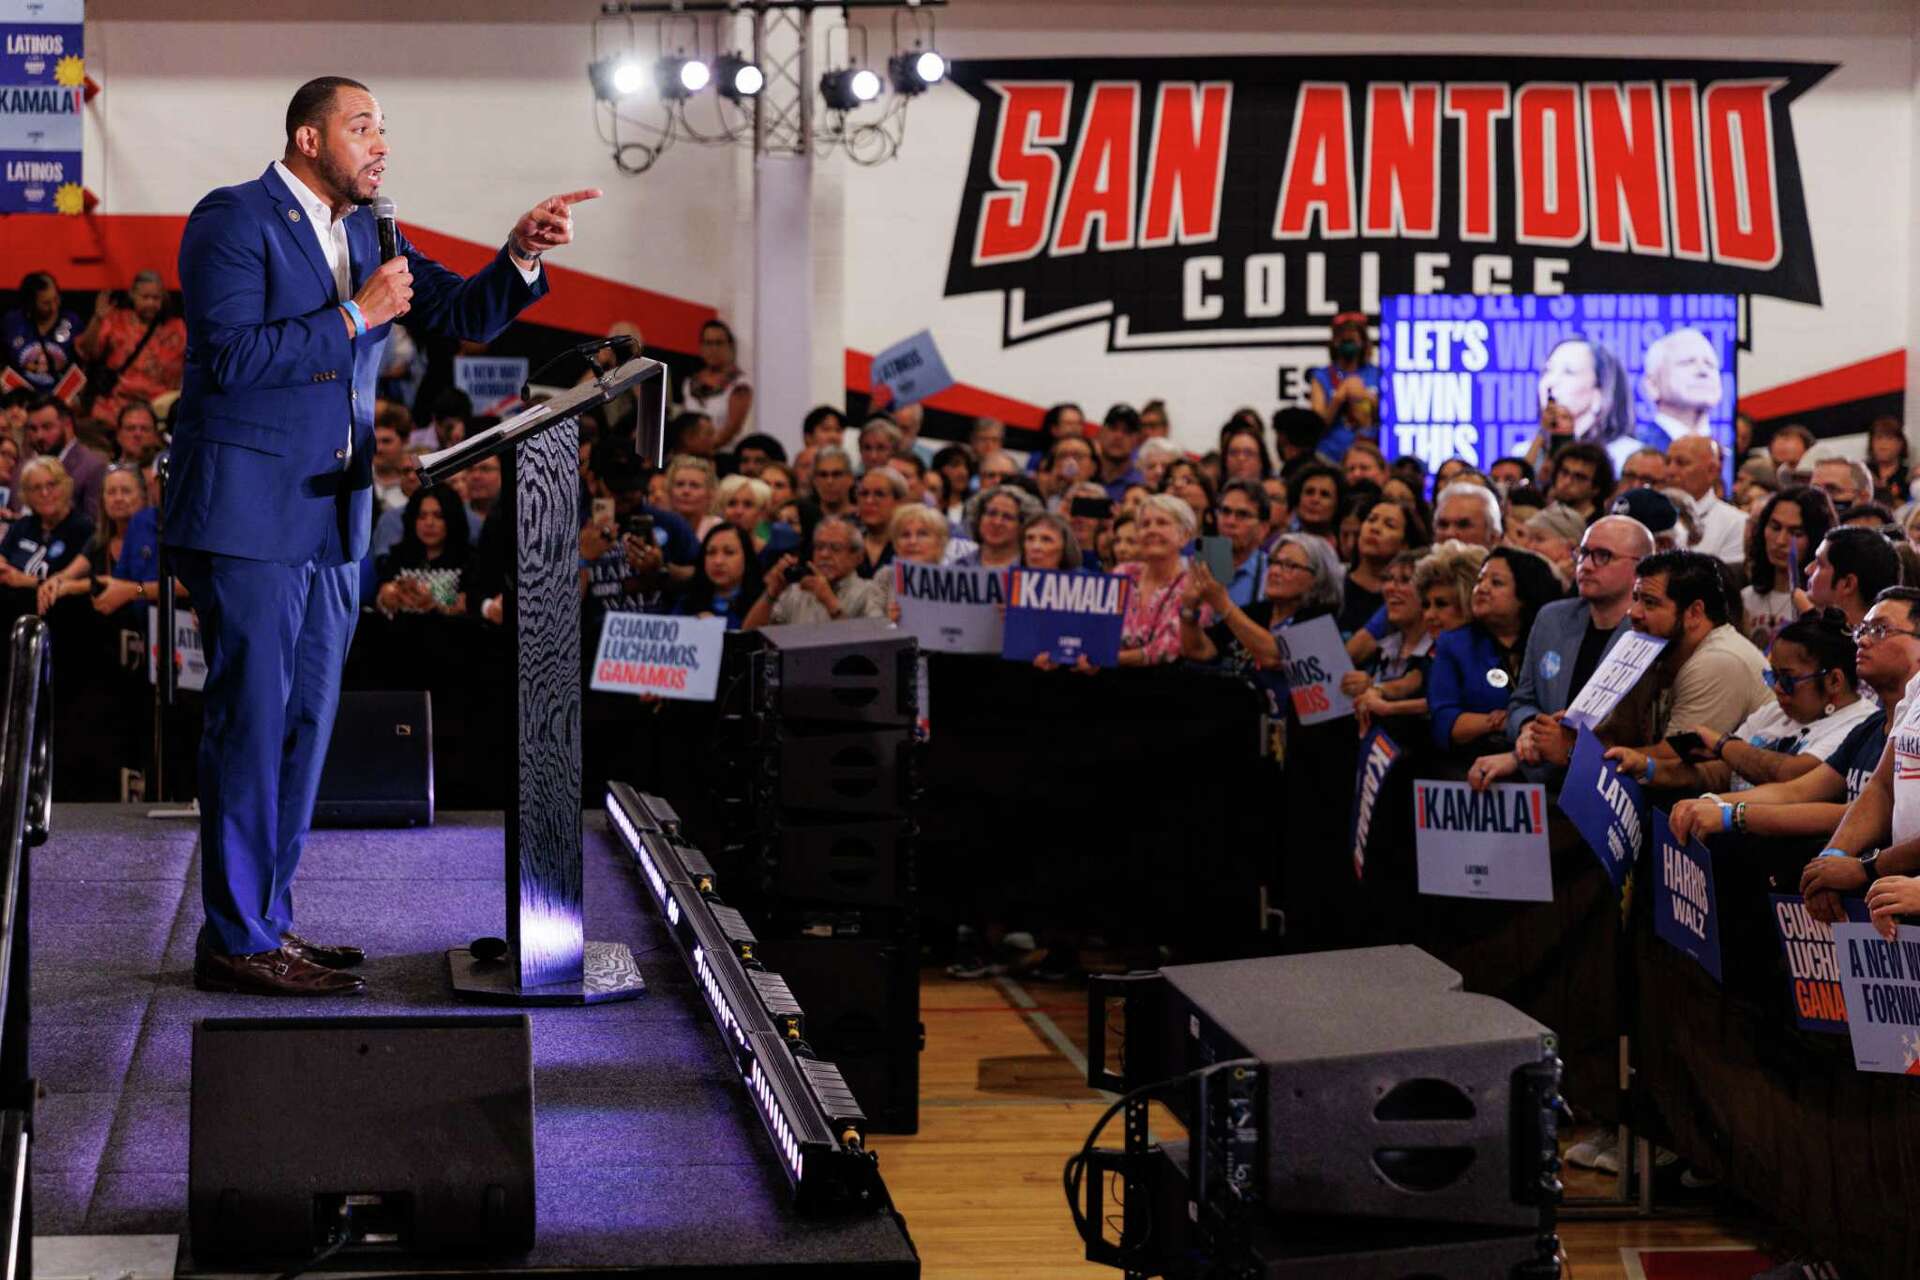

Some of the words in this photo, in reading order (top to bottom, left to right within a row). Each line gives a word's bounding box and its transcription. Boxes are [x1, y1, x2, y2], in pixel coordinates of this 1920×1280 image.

[7, 34, 63, 55] LATINOS
[7, 161, 63, 182] LATINOS
[972, 80, 1234, 268] SAN
[1272, 78, 1790, 271] ANTONIO
[1394, 319, 1489, 372] LET'S
[1392, 371, 1472, 423] WIN
[1393, 423, 1479, 476] THIS
[608, 616, 679, 642] CUANDO
[598, 661, 687, 690] GANAMOS
[602, 639, 700, 670] LUCHAMOS,
[1417, 786, 1544, 836] ¡KAMALA!
[1596, 765, 1643, 862] LATINOS
[1662, 842, 1709, 915] HARRIS
[1672, 894, 1706, 941] WALZ
[1776, 902, 1835, 942] CUAN
[1785, 940, 1841, 982] LUCH
[1848, 938, 1865, 978] A
[1863, 938, 1905, 980] NEW
[1795, 977, 1849, 1023] GANA
[1862, 983, 1920, 1026] FORWA
